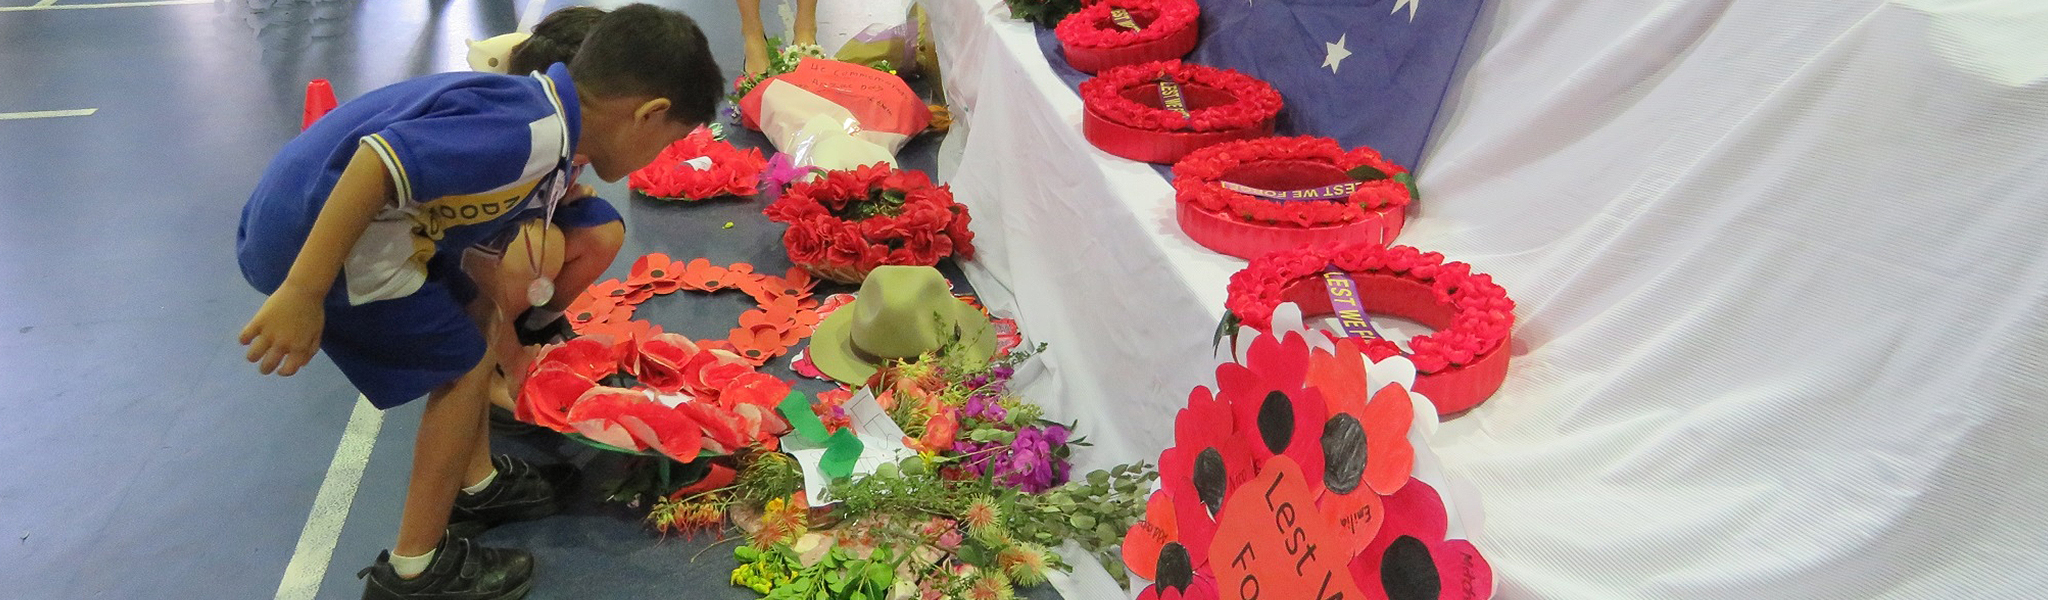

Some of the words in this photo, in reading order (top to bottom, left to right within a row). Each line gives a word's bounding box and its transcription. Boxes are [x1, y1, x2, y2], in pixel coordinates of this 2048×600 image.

[1292, 190, 1318, 199] WE
[1323, 271, 1357, 307] LEST
[1338, 309, 1368, 328] WE
[1264, 471, 1317, 577] Lest
[1340, 504, 1372, 535] Emilia
